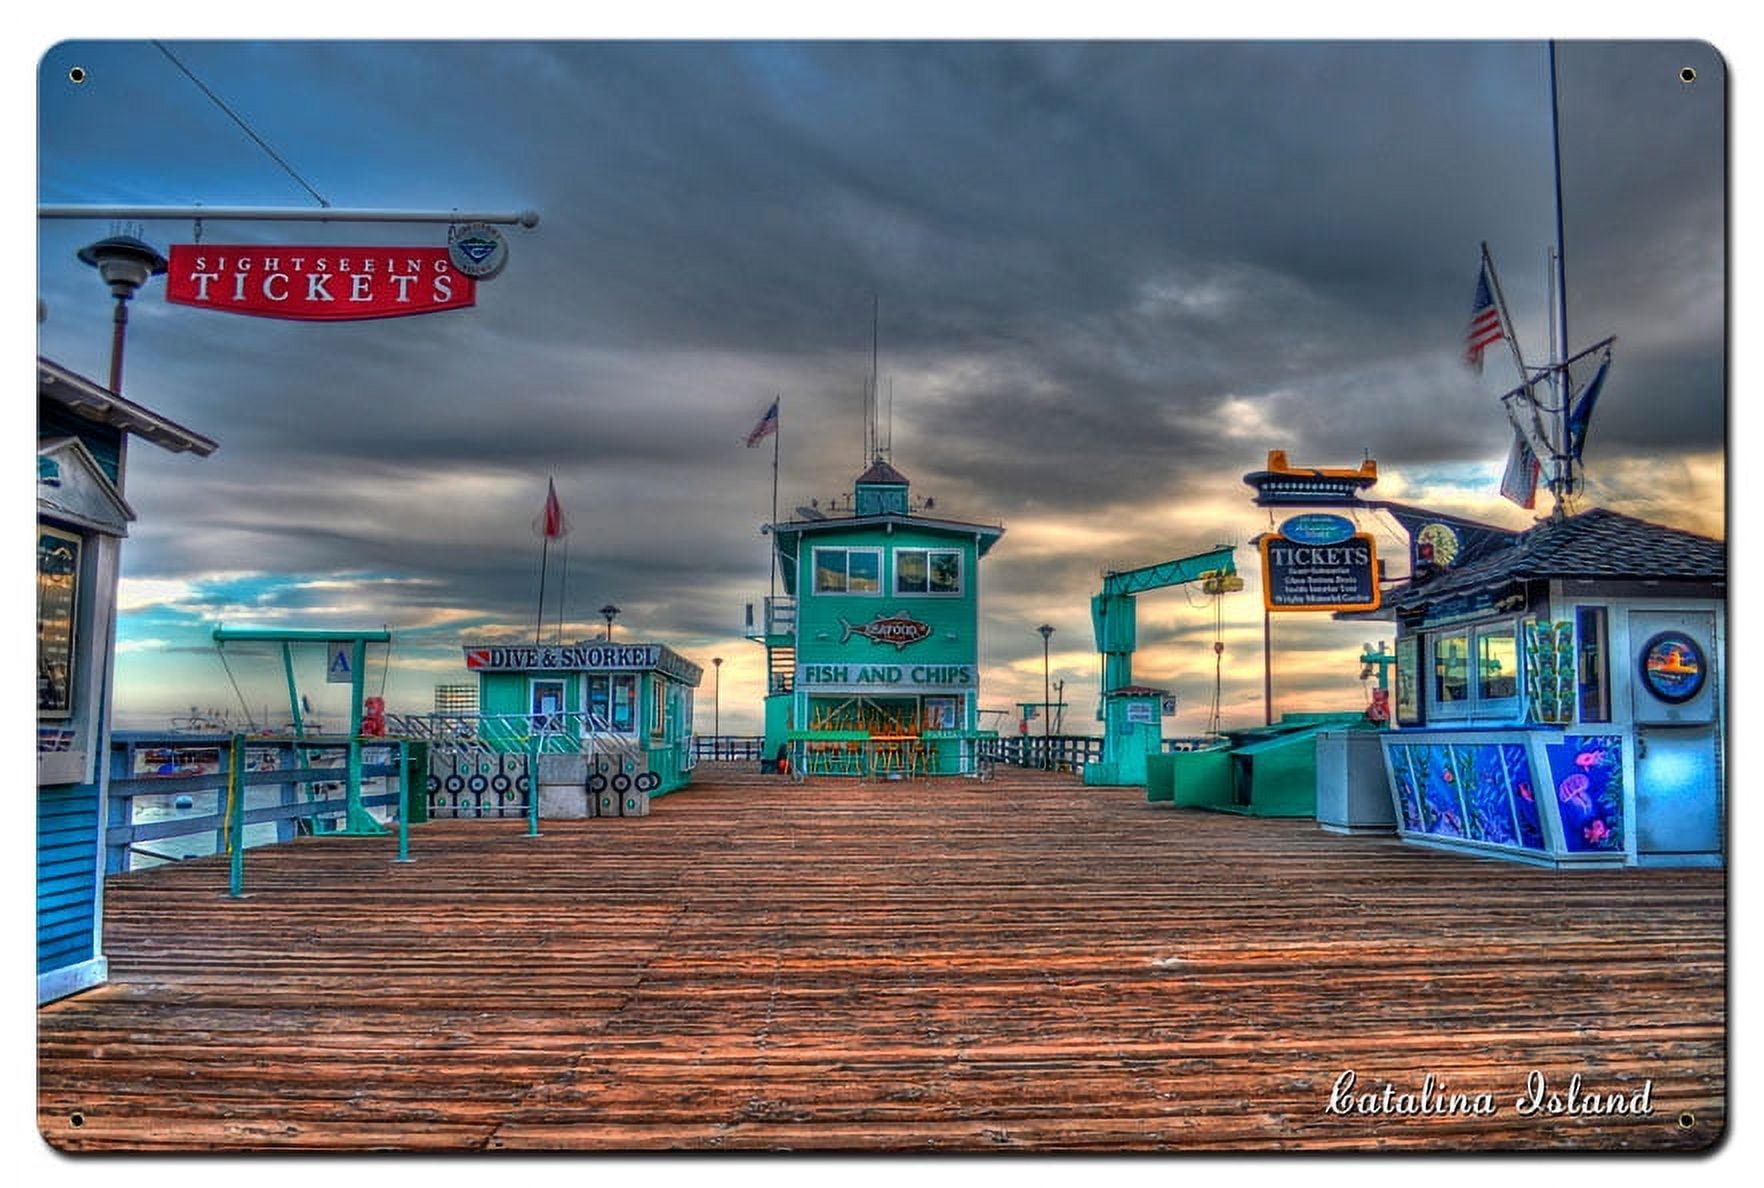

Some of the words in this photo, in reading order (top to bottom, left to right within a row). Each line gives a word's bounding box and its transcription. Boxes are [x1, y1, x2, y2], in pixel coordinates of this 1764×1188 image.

[196, 256, 449, 273] SIGHTSEEING
[191, 273, 453, 303] TICKETS
[1270, 547, 1368, 566] TICKETS
[331, 650, 350, 672] A
[490, 649, 537, 668] DIVE
[543, 649, 556, 668] &
[560, 648, 658, 667] SNORKEL
[805, 666, 848, 683] FISH
[857, 666, 900, 683] AND
[911, 666, 970, 683] CHIPS
